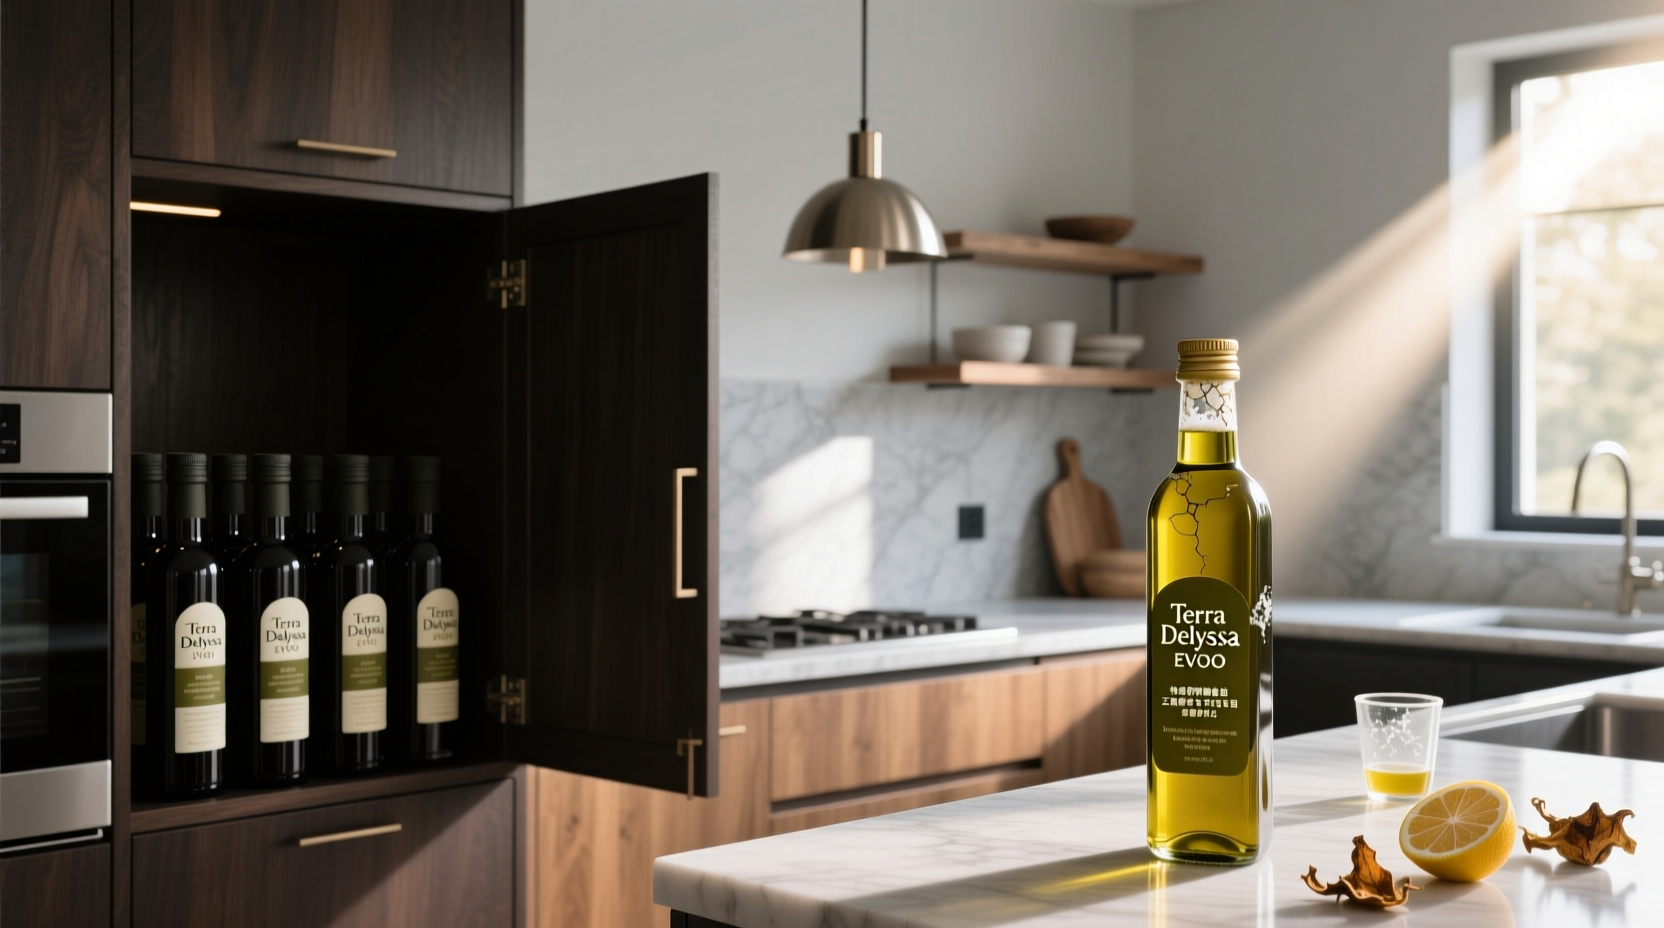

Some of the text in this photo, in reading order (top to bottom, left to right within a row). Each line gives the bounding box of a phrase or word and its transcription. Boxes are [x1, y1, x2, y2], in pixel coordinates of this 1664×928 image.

[1170, 603, 1226, 624] Terra
[186, 622, 216, 635] Terra
[1161, 624, 1240, 652] Delyssa
[1174, 652, 1226, 668] EVOO
